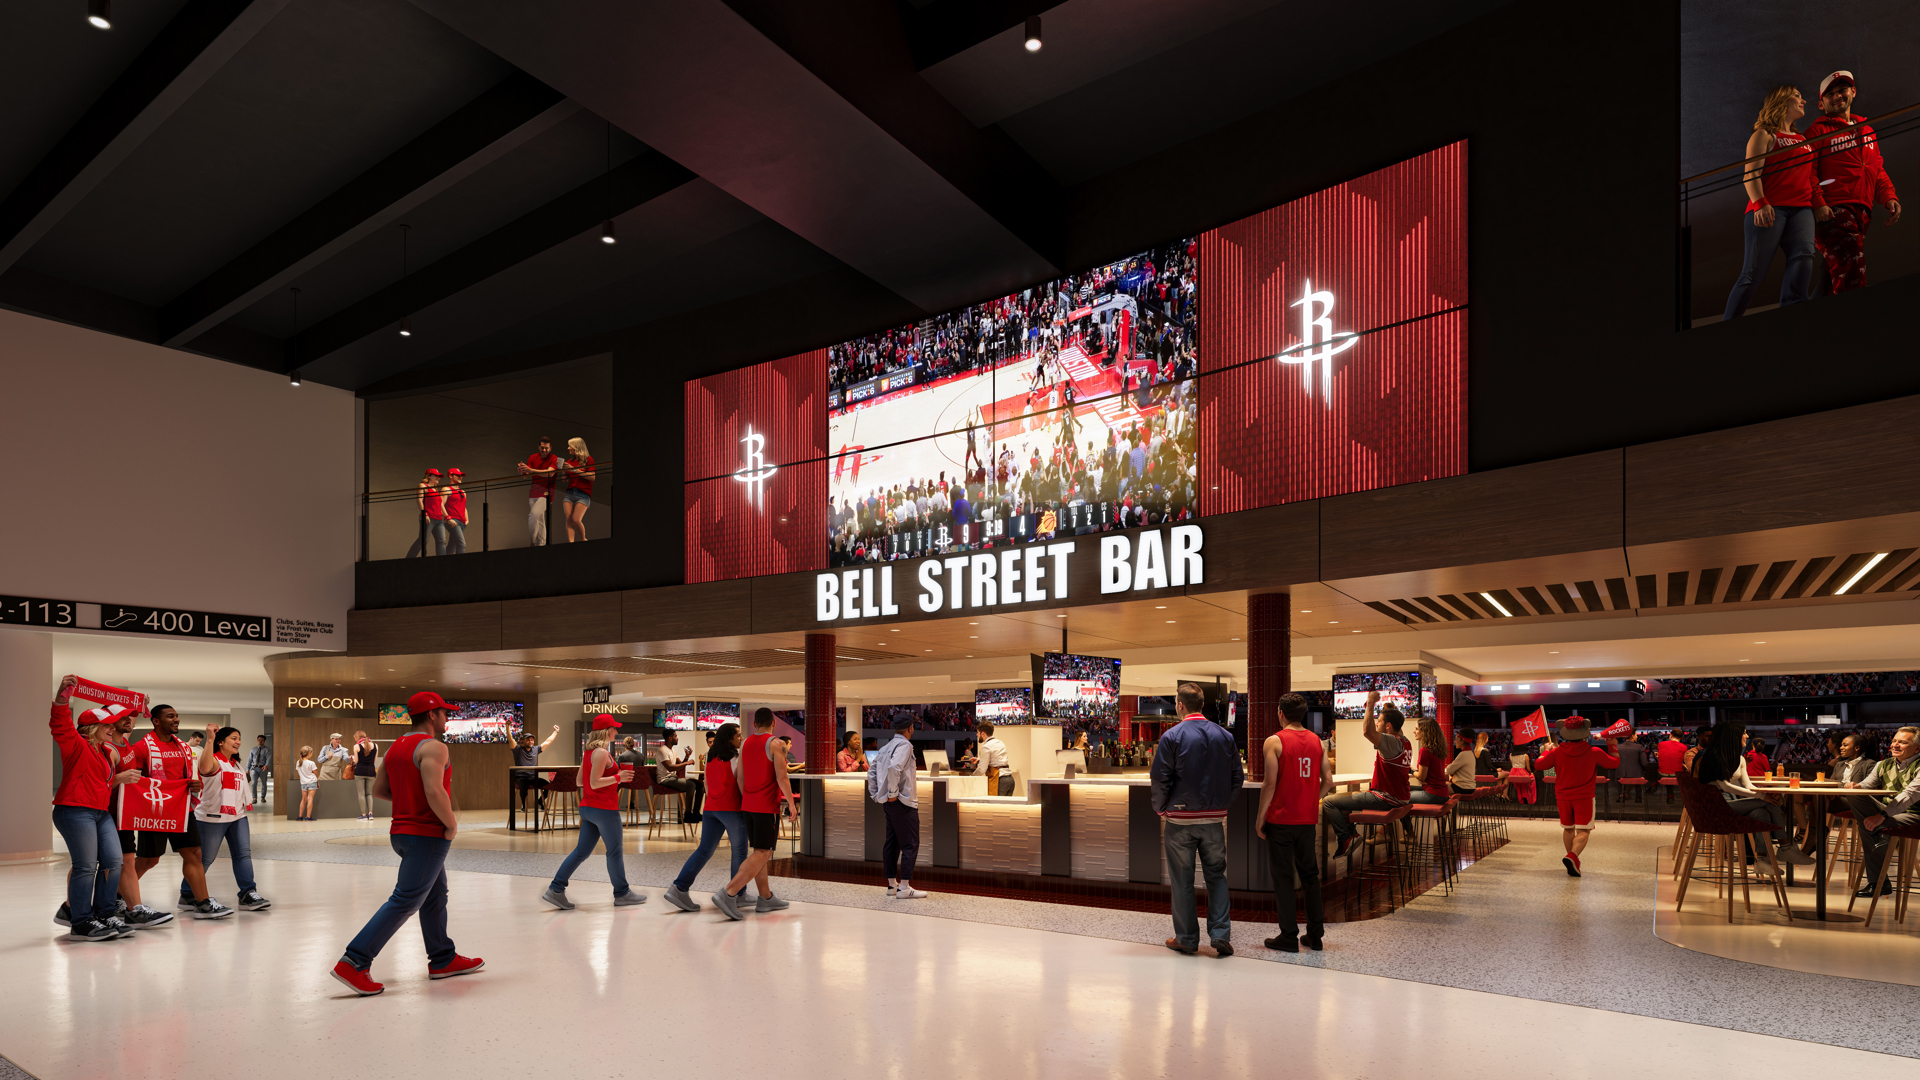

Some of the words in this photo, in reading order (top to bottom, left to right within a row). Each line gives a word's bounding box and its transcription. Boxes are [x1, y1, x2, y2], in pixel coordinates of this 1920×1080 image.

[1831, 133, 1875, 153] ROCKTS
[963, 523, 970, 544] 9
[1020, 515, 1026, 536] 4
[816, 565, 899, 622] BELL
[917, 541, 1076, 614] STREET
[1100, 524, 1204, 595] BAR
[143, 610, 194, 633] 400
[204, 615, 266, 638] Level
[78, 684, 106, 699] HOUSTON
[106, 691, 130, 704] ROCKETS
[287, 696, 364, 710] POPCORN
[584, 690, 594, 703] 102
[598, 688, 608, 702] 101
[583, 703, 629, 714] DRINKS
[1608, 724, 1631, 735] ROCKETS
[1298, 757, 1311, 778] 13
[133, 816, 177, 830] ROCKETS
